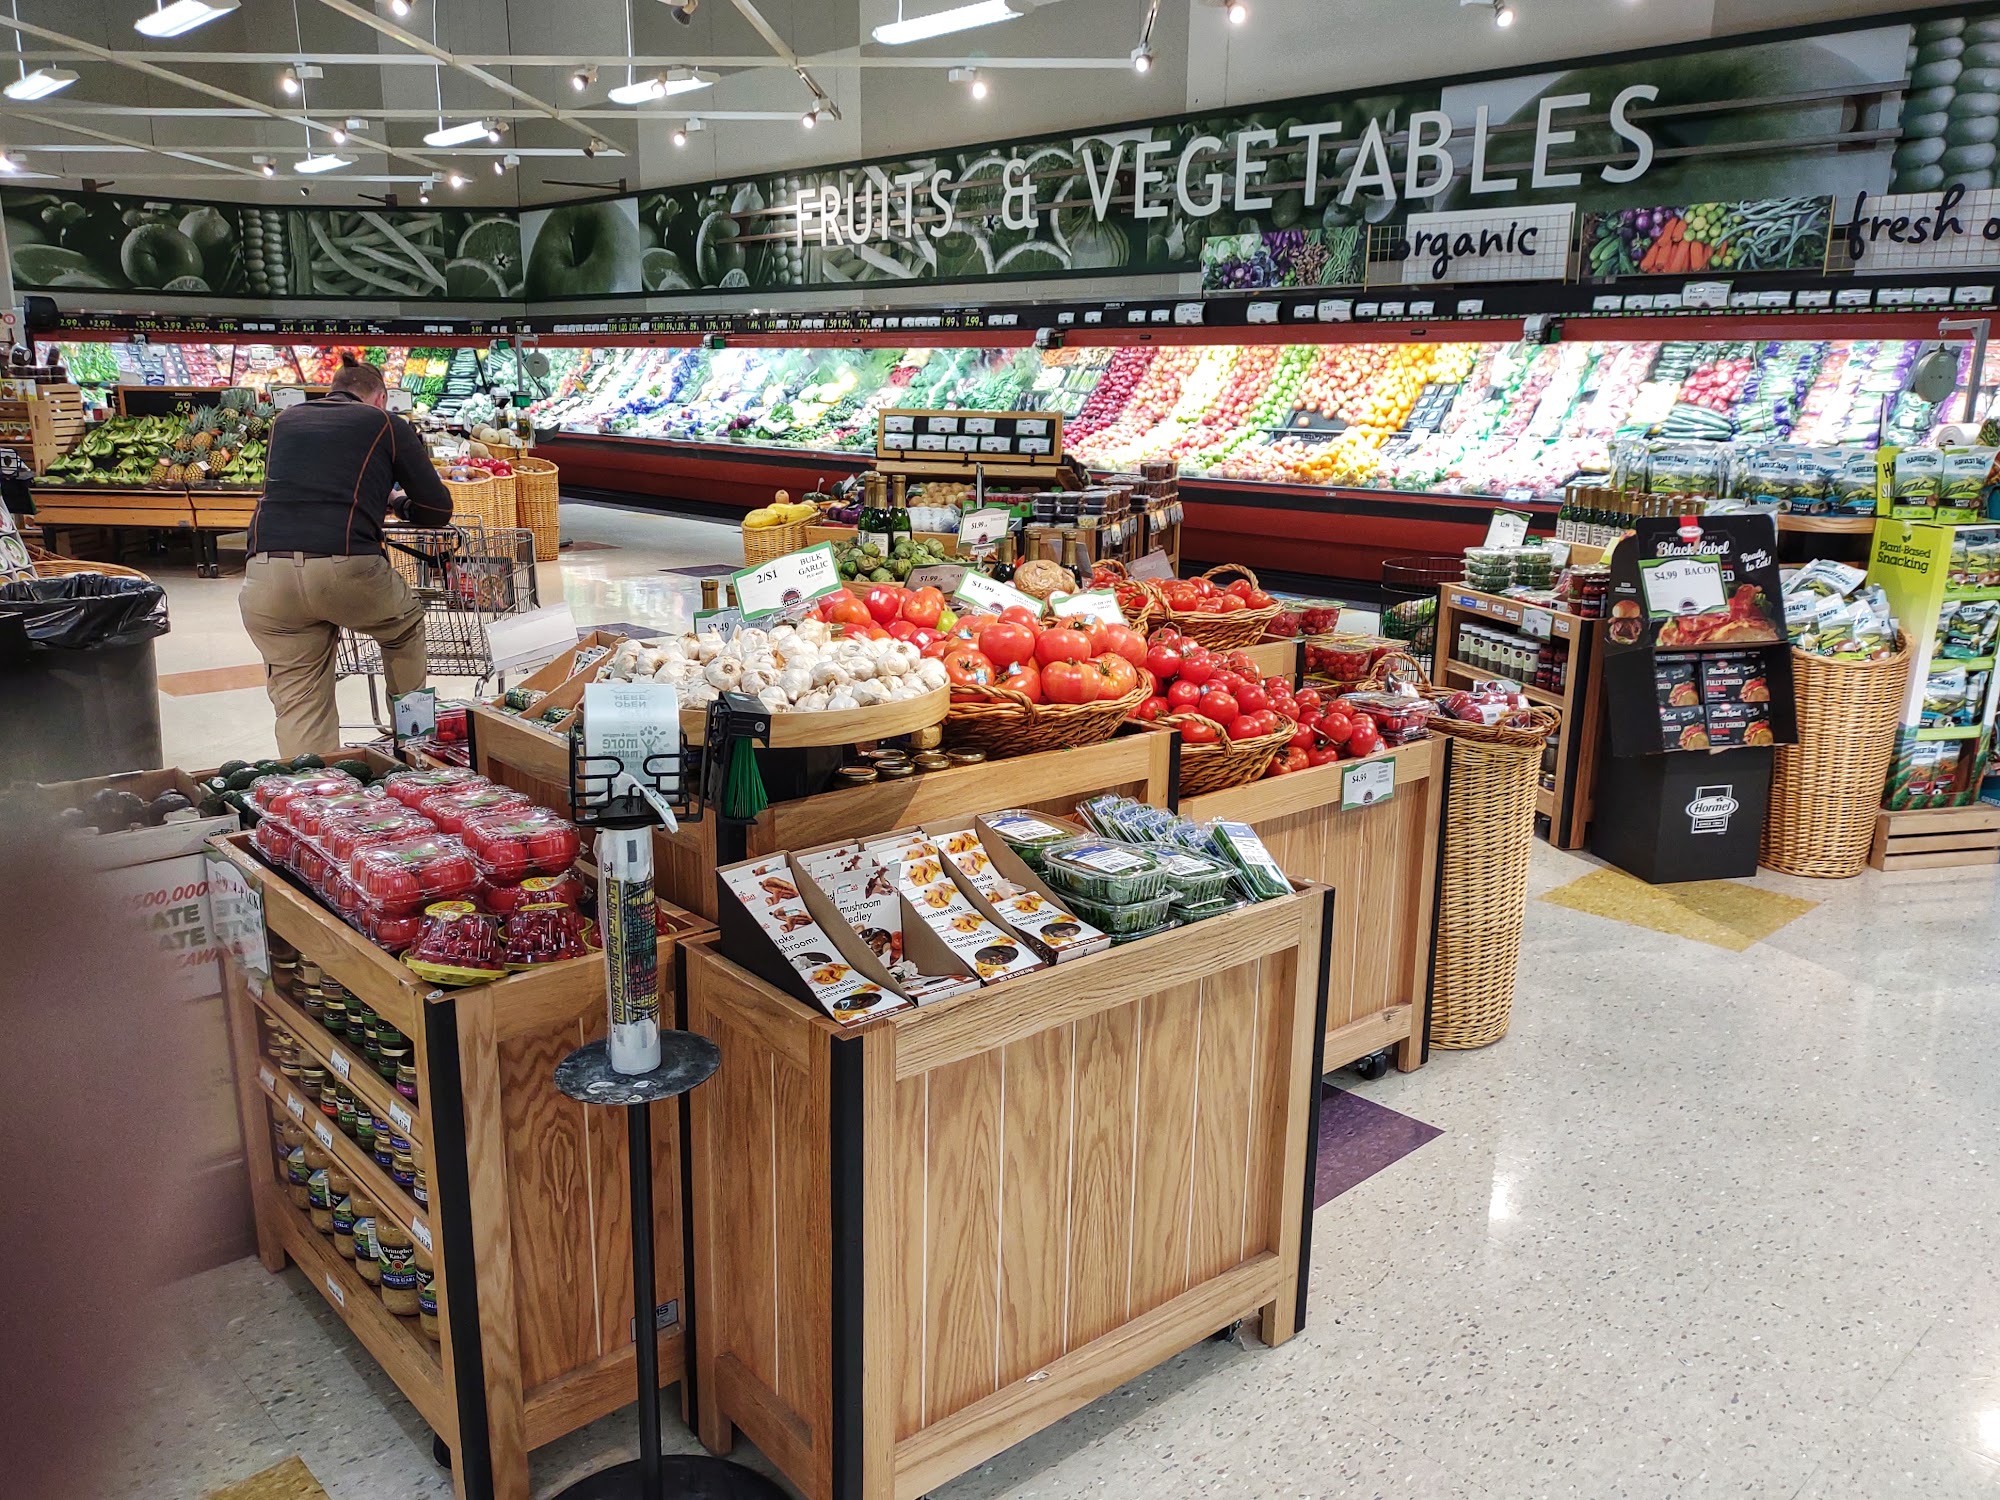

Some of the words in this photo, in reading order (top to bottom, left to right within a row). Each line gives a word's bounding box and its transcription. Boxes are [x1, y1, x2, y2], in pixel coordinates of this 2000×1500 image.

[796, 168, 953, 249] FRUITS
[1001, 158, 1039, 230] &
[1081, 84, 1660, 222] VEGETABLES
[1849, 183, 1966, 260] fresh
[1392, 221, 1538, 279] organic
[1656, 541, 1694, 558] Black
[1697, 540, 1730, 555] Label
[1740, 548, 1767, 563] Ready
[1879, 541, 1931, 558] Plant-Based
[800, 552, 823, 566] BULK
[1745, 562, 1754, 572] to
[1755, 555, 1773, 570] Eat!
[1876, 551, 1929, 574] Snacking
[798, 560, 829, 576] GARLIC
[1654, 570, 1678, 581] $4.99
[1684, 566, 1718, 576] BACON
[757, 569, 778, 584] 2/$1
[971, 580, 995, 593] $1.99
[1694, 802, 1731, 813] Hormel
[840, 900, 881, 914] mushroom
[845, 912, 872, 923] edley
[1011, 910, 1053, 923] chanterelle
[1018, 913, 1060, 927] mushrooms
[947, 929, 992, 944] chanterelle
[953, 934, 999, 950] mushrooms
[382, 1246, 413, 1255] Christopher
